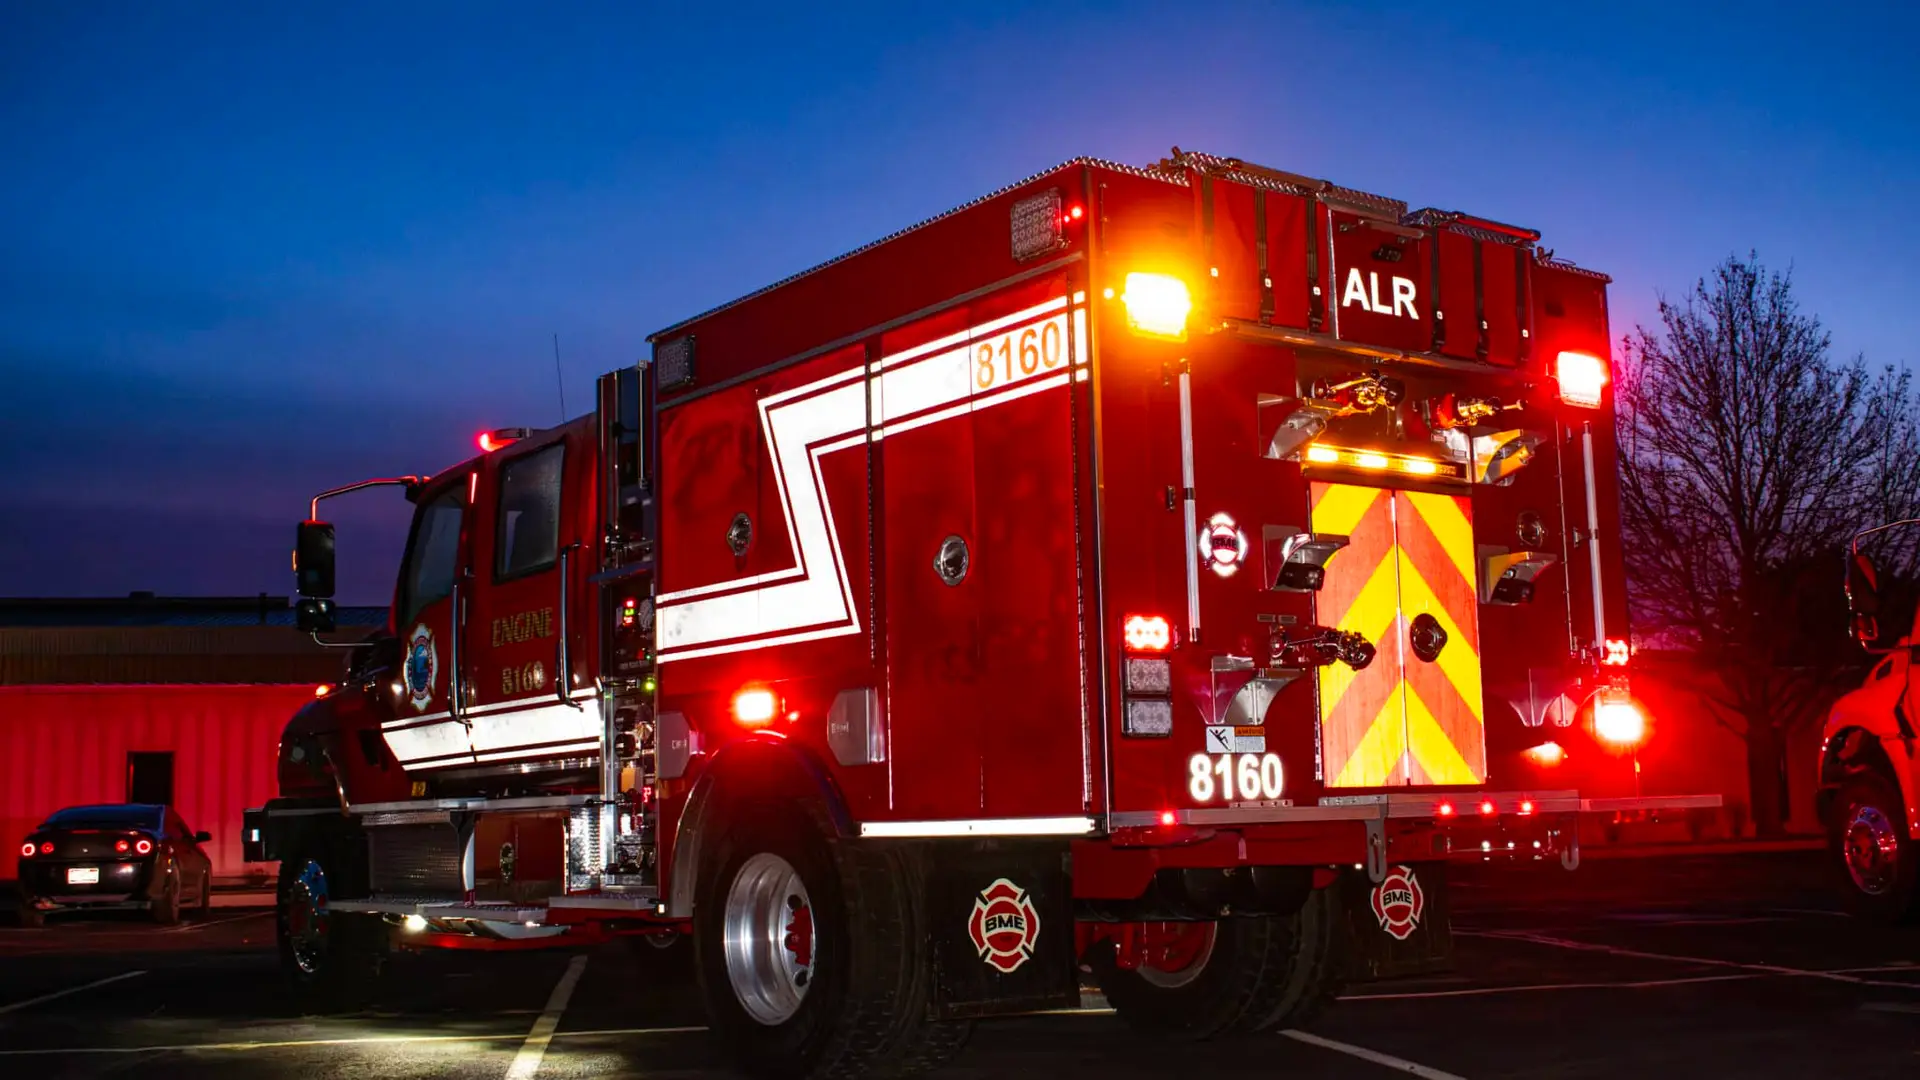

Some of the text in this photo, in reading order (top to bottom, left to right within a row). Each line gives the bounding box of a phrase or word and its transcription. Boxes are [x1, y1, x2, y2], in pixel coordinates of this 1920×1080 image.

[1342, 268, 1419, 320] ALR
[977, 321, 1060, 388] 8160
[492, 607, 553, 648] ENGINE
[502, 660, 545, 695] 8160
[1190, 753, 1284, 801] 8160
[1383, 890, 1412, 906] BME
[985, 914, 1025, 933] BME
